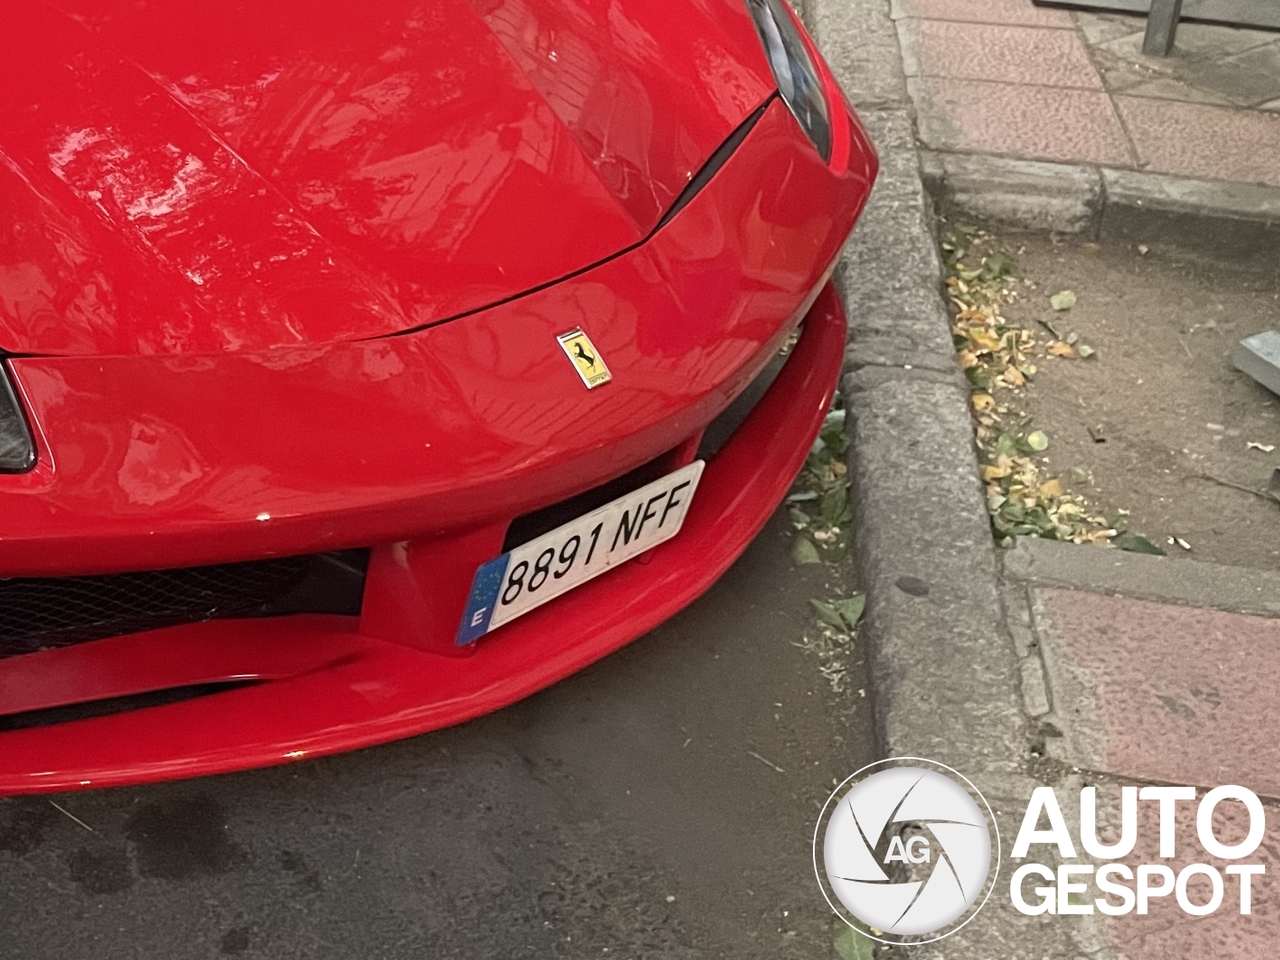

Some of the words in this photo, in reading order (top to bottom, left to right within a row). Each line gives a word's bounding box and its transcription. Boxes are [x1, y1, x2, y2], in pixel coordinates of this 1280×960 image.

[500, 522, 604, 606] 8891
[609, 479, 692, 554] NFF
[470, 607, 487, 627] E
